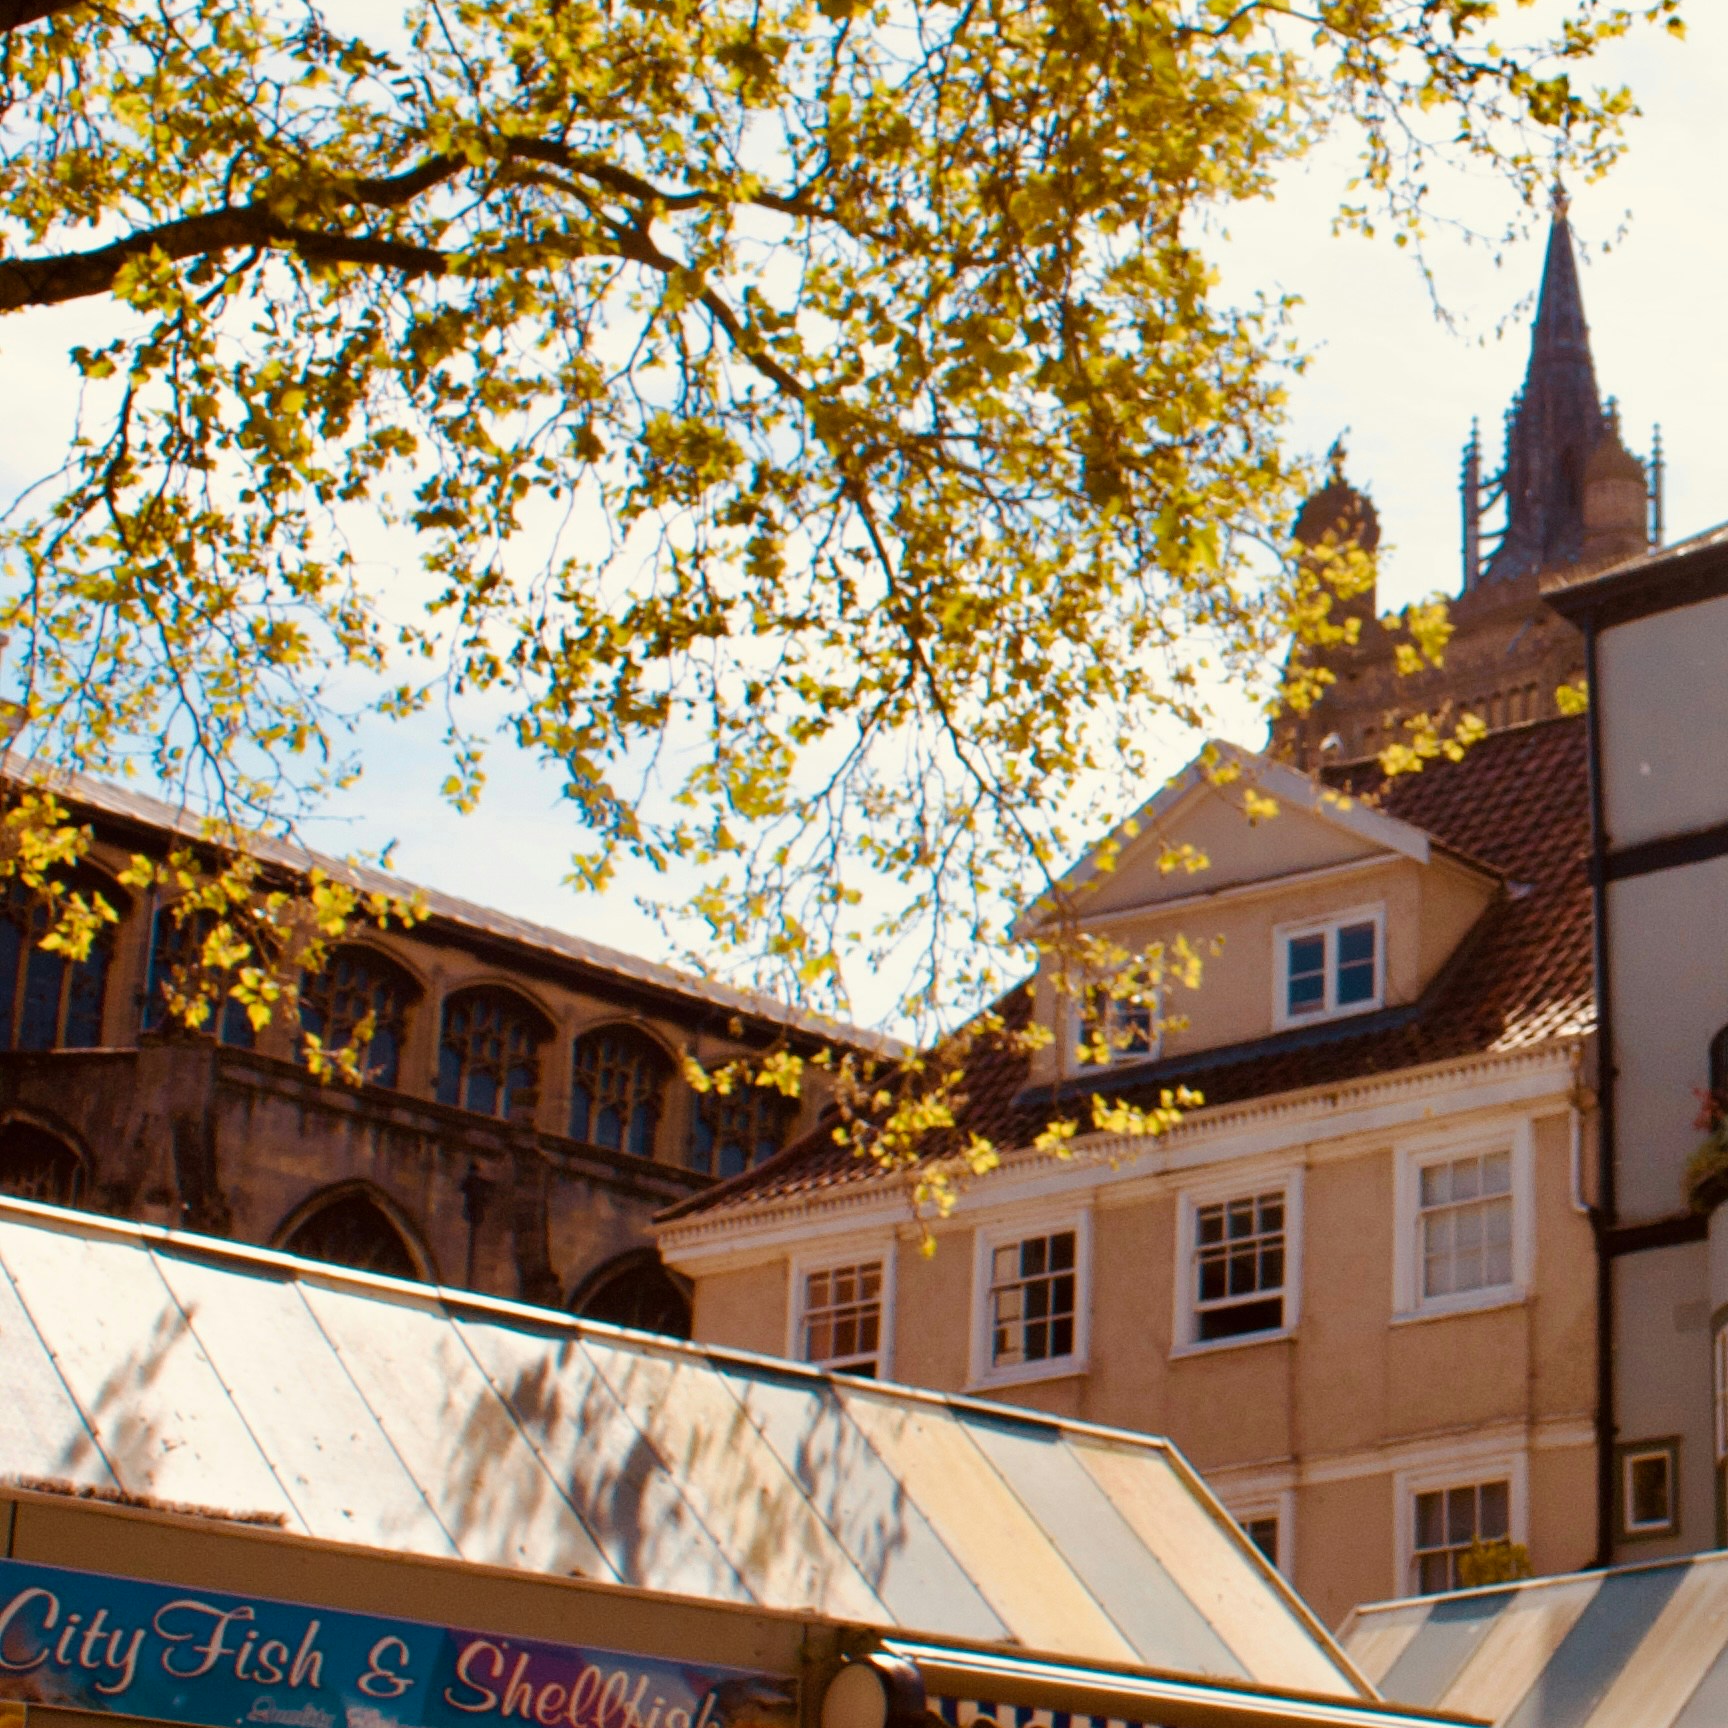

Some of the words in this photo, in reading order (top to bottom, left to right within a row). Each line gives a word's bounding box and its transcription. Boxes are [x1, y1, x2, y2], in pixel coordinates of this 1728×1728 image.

[0, 1587, 146, 1695] City
[153, 1599, 324, 1689] Fish
[358, 1635, 415, 1698] &
